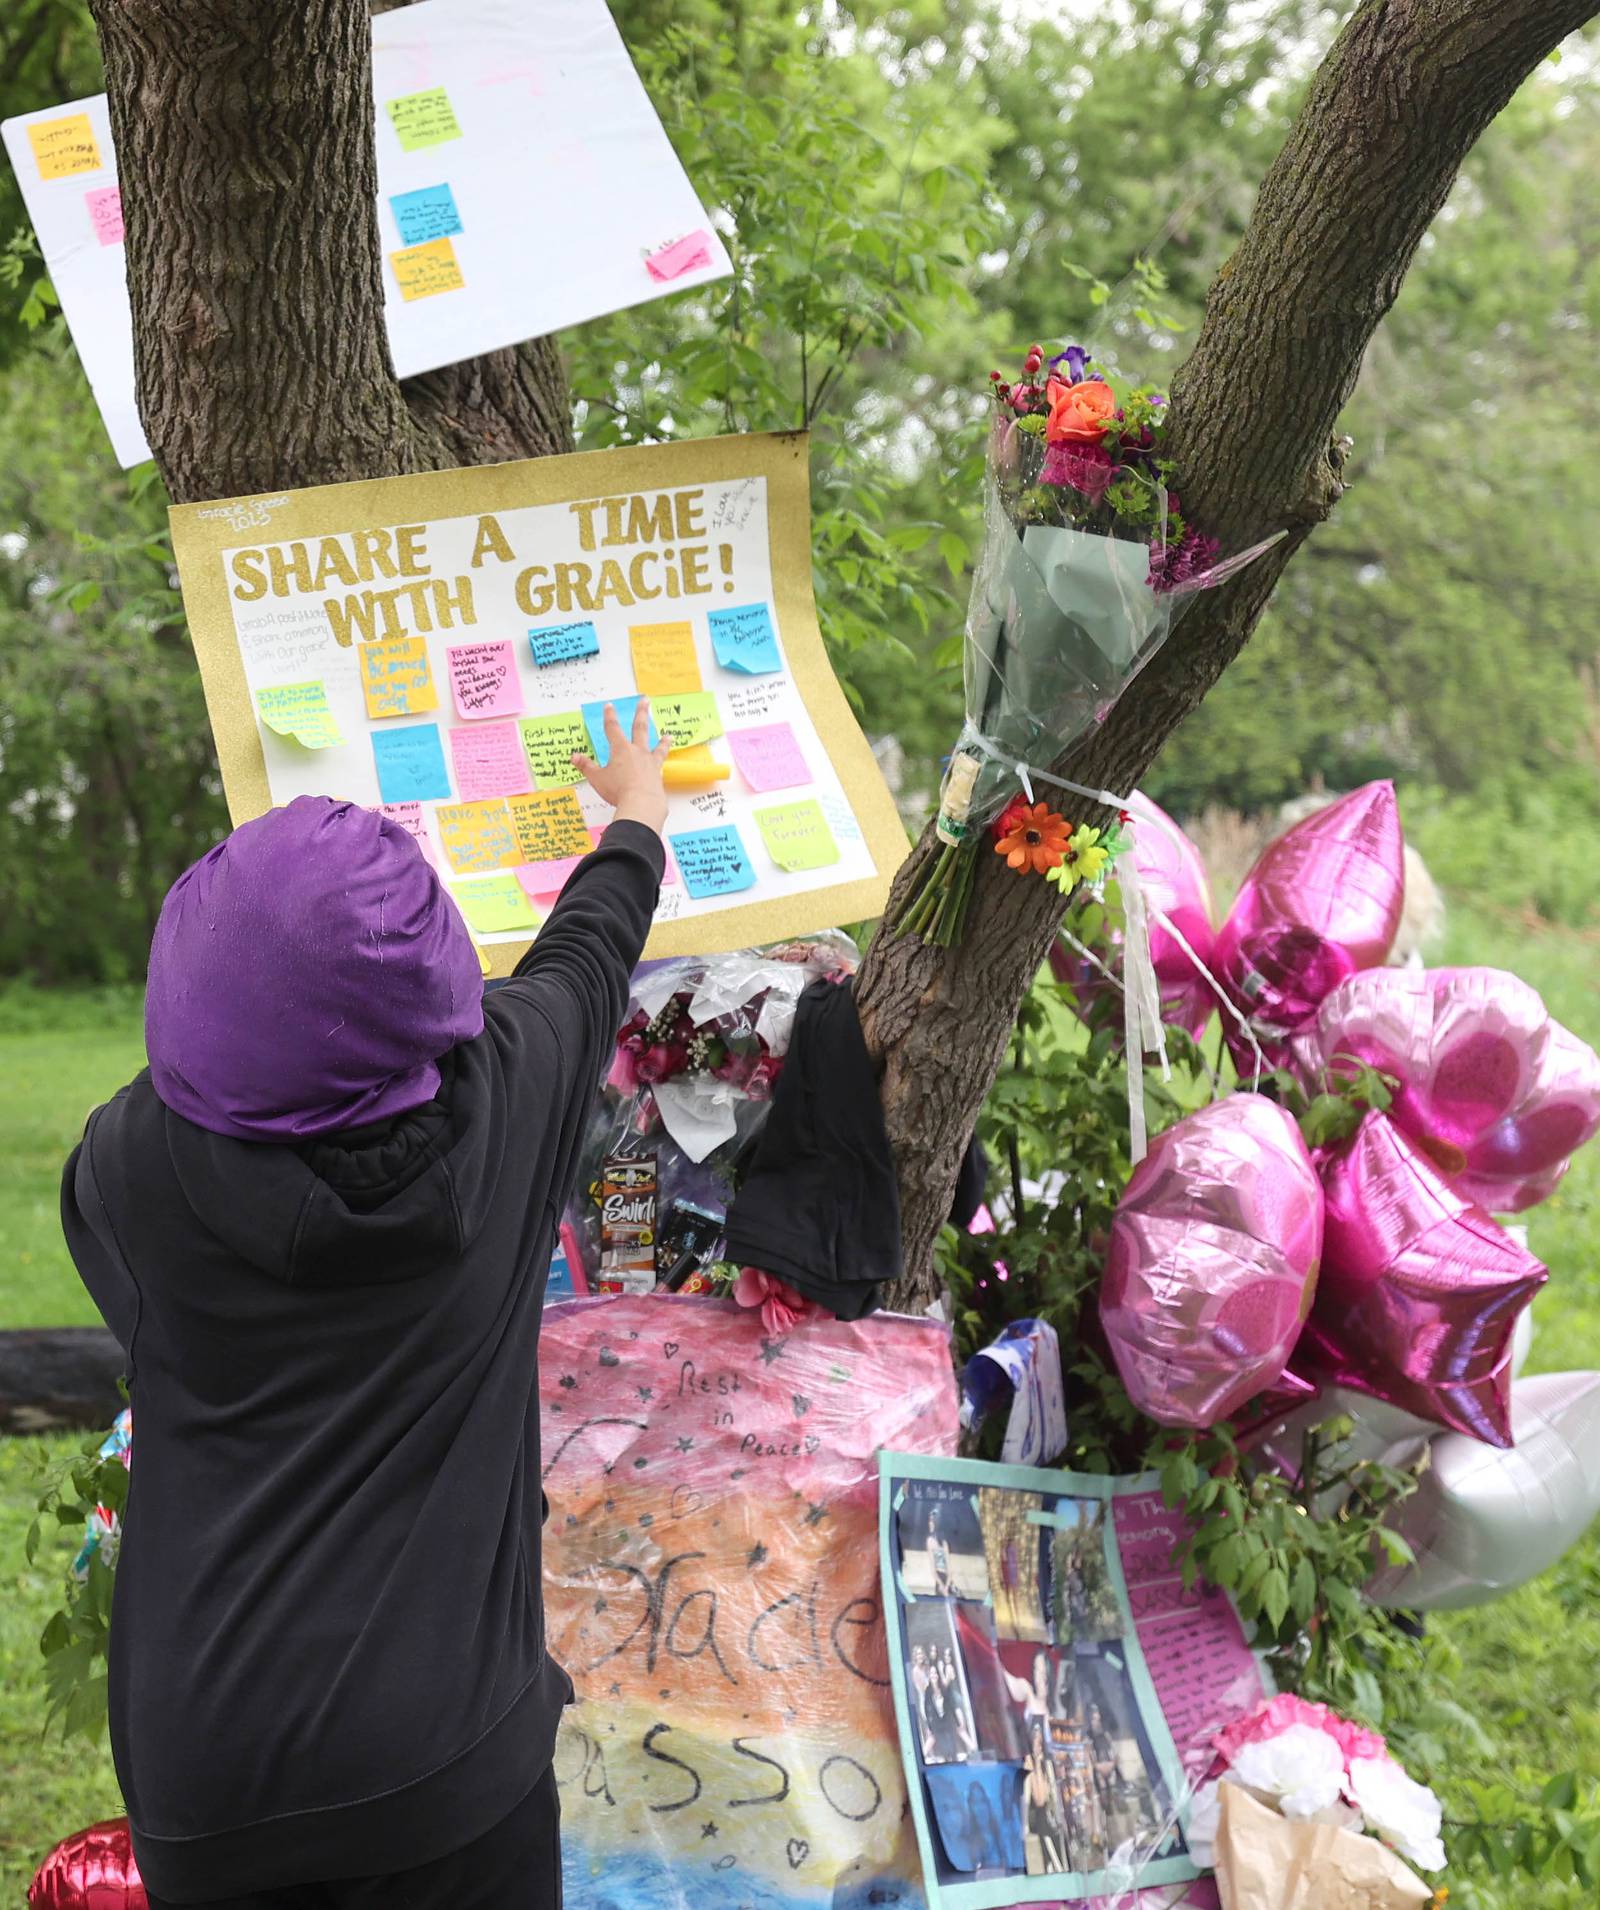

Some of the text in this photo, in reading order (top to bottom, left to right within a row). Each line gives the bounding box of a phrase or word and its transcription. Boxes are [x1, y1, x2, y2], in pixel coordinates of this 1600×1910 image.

[231, 489, 706, 602] SHARE A TIME
[323, 575, 477, 648] WITH
[677, 1360, 743, 1397] Rest
[713, 1409, 735, 1426] in
[740, 1433, 801, 1456] Peace
